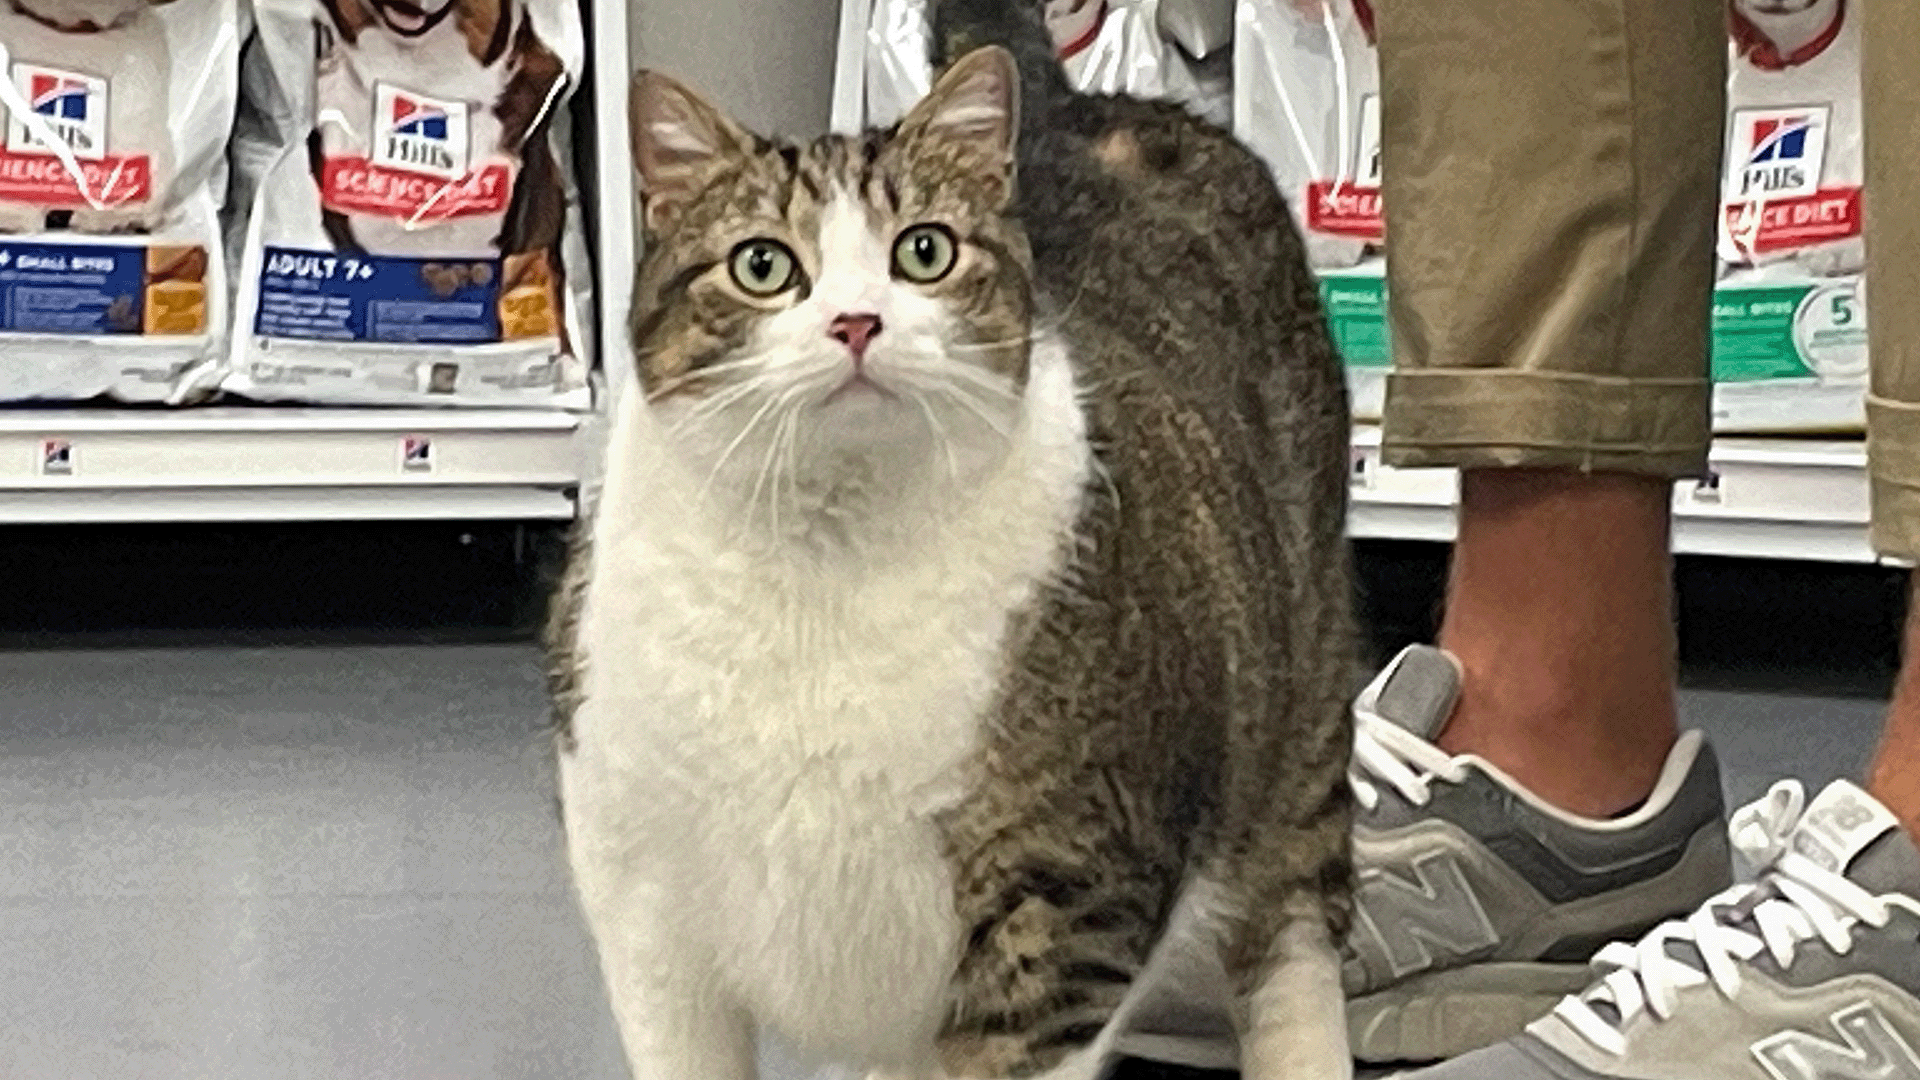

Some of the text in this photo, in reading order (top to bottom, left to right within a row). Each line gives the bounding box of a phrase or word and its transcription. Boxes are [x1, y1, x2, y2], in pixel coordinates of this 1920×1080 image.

[266, 252, 375, 281] ADULT 7+
[1831, 294, 1855, 326] 5
